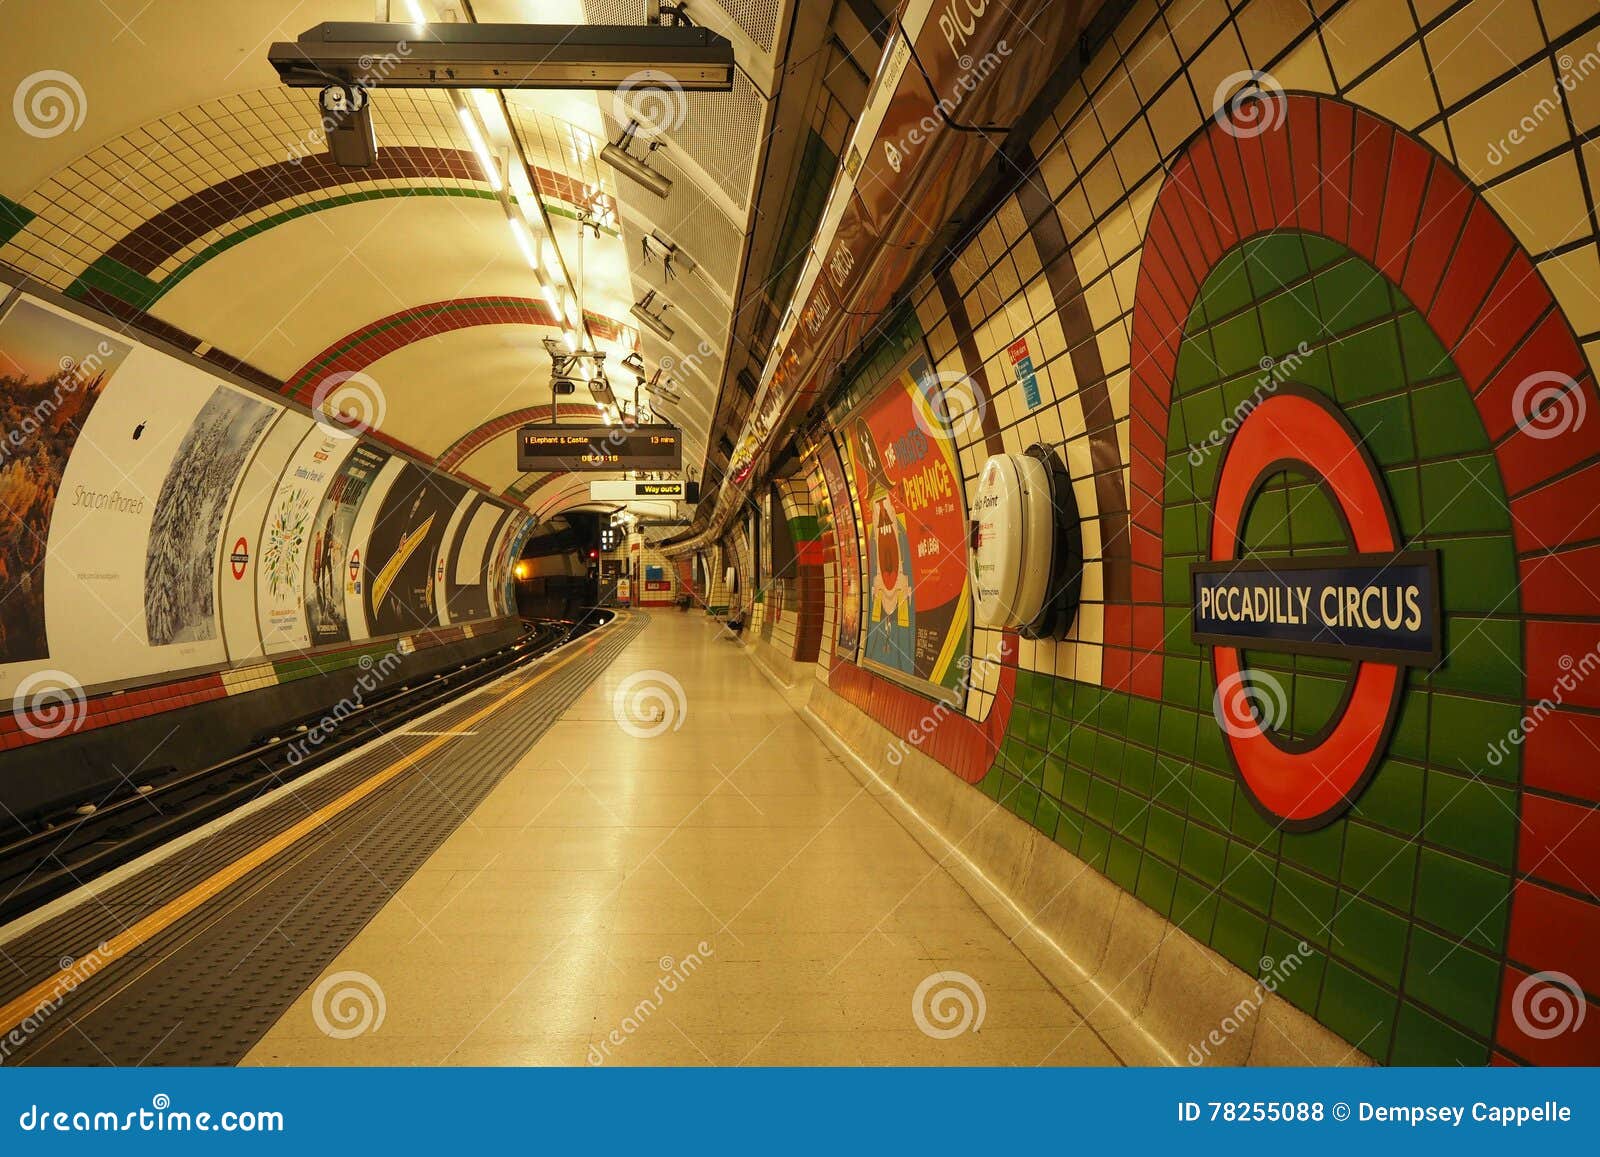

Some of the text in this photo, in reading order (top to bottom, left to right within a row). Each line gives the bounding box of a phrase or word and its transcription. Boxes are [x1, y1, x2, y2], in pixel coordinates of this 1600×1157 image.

[72, 485, 96, 508] Shot
[645, 486, 660, 495] Way
[902, 459, 952, 511] PENZANCE
[1200, 585, 1422, 632] PICCADILLY CIRCUS
